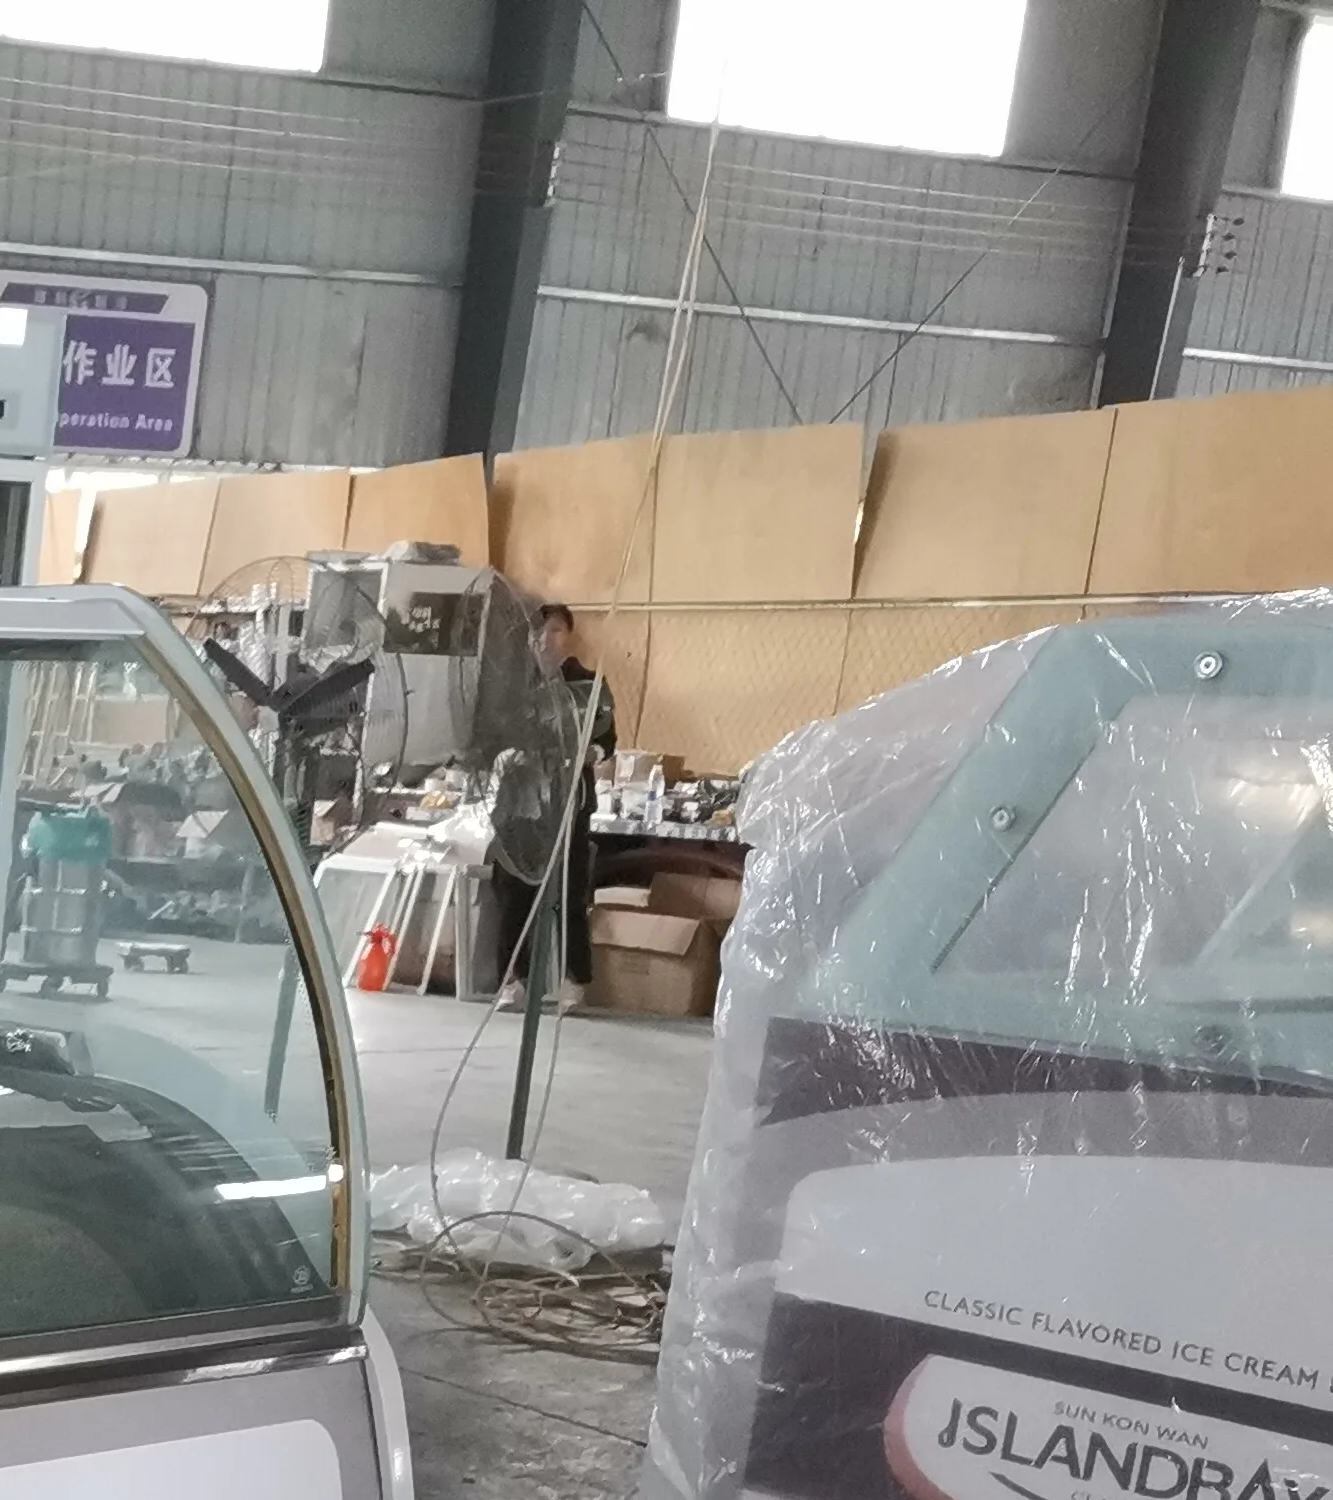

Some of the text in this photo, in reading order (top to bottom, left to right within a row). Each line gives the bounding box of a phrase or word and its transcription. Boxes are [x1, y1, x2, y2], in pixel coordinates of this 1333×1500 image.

[63, 340, 177, 388] 作业区
[59, 412, 174, 432] peration Area
[924, 1290, 1023, 1327] CLASSIC
[1032, 1311, 1163, 1356] FLAVORED
[1171, 1340, 1213, 1367] ICE
[1225, 1351, 1320, 1391] CREAM
[1053, 1401, 1209, 1449] SUN KON WAN
